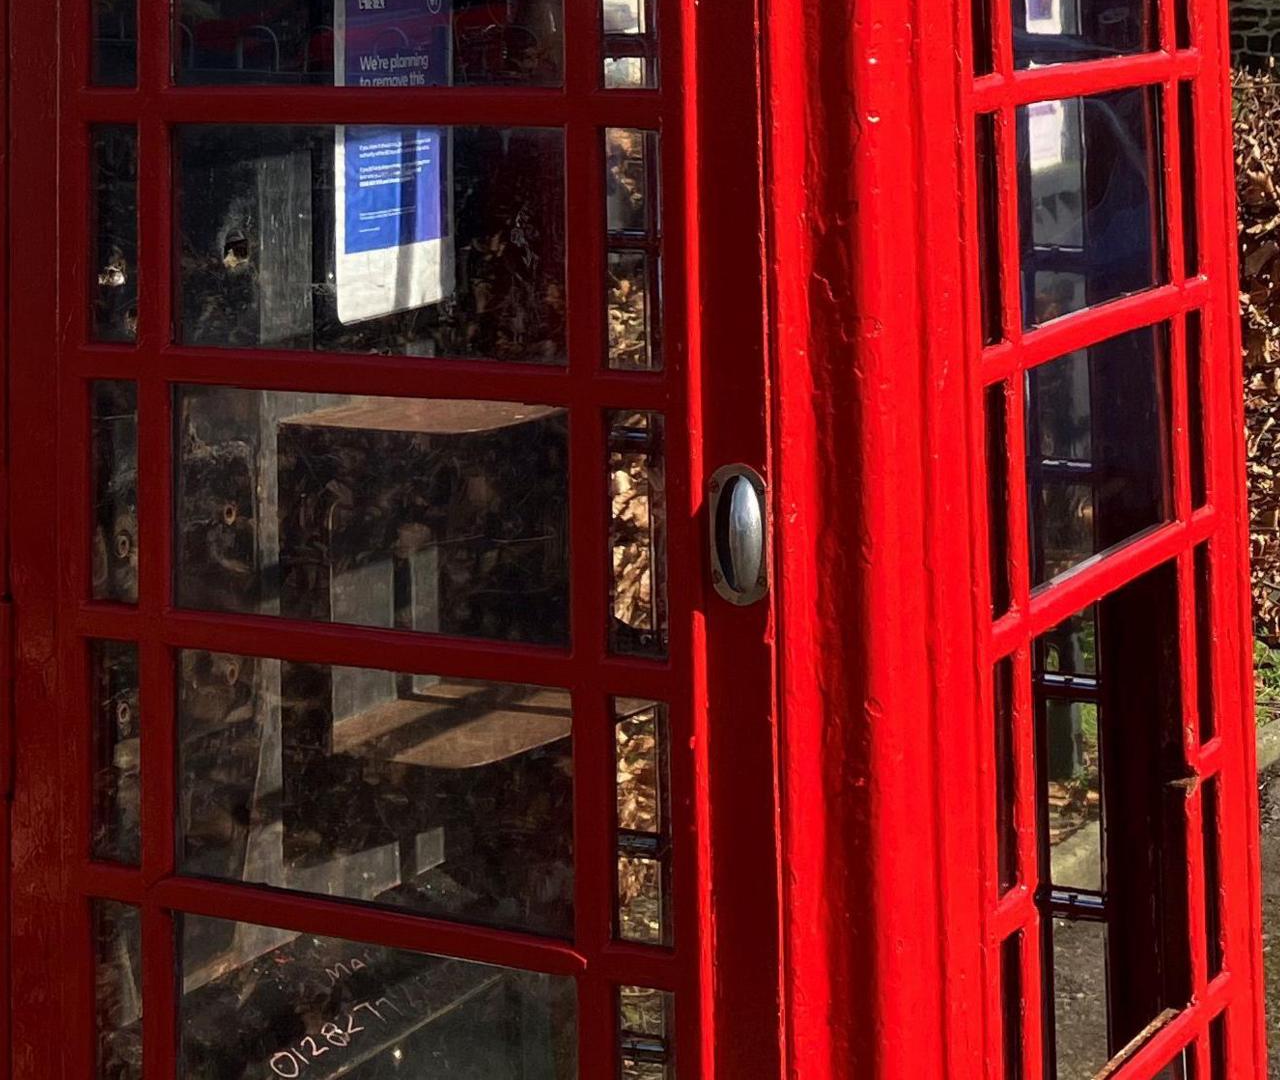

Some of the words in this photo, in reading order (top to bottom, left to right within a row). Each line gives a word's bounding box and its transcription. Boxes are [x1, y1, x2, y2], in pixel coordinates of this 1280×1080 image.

[360, 55, 389, 71] We're
[390, 52, 429, 72] planning
[372, 75, 409, 87] remove
[410, 70, 425, 85] this
